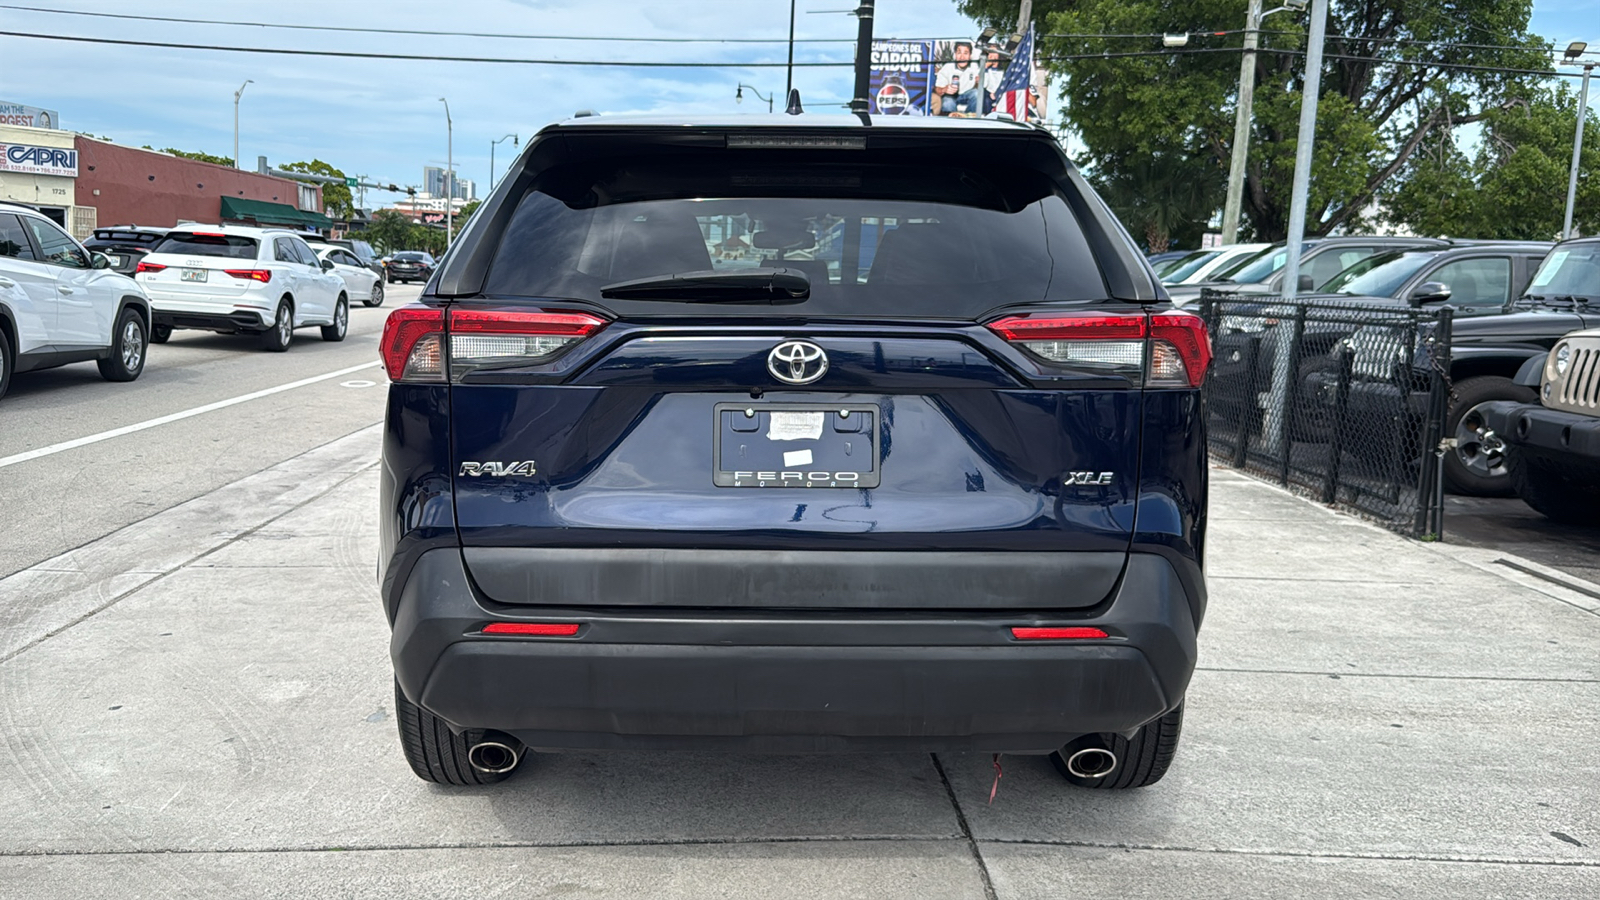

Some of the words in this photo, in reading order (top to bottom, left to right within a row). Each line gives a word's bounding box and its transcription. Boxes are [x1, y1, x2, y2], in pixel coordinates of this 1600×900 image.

[871, 41, 909, 52] CAMPEONES
[910, 43, 922, 53] DEL
[870, 52, 922, 72] SABOR
[879, 97, 906, 105] PEPSI
[11, 106, 24, 114] THE
[7, 146, 76, 168] CAPRI
[458, 460, 536, 477] RAV4
[734, 471, 858, 480] FERCO
[1064, 471, 1114, 485] XLE
